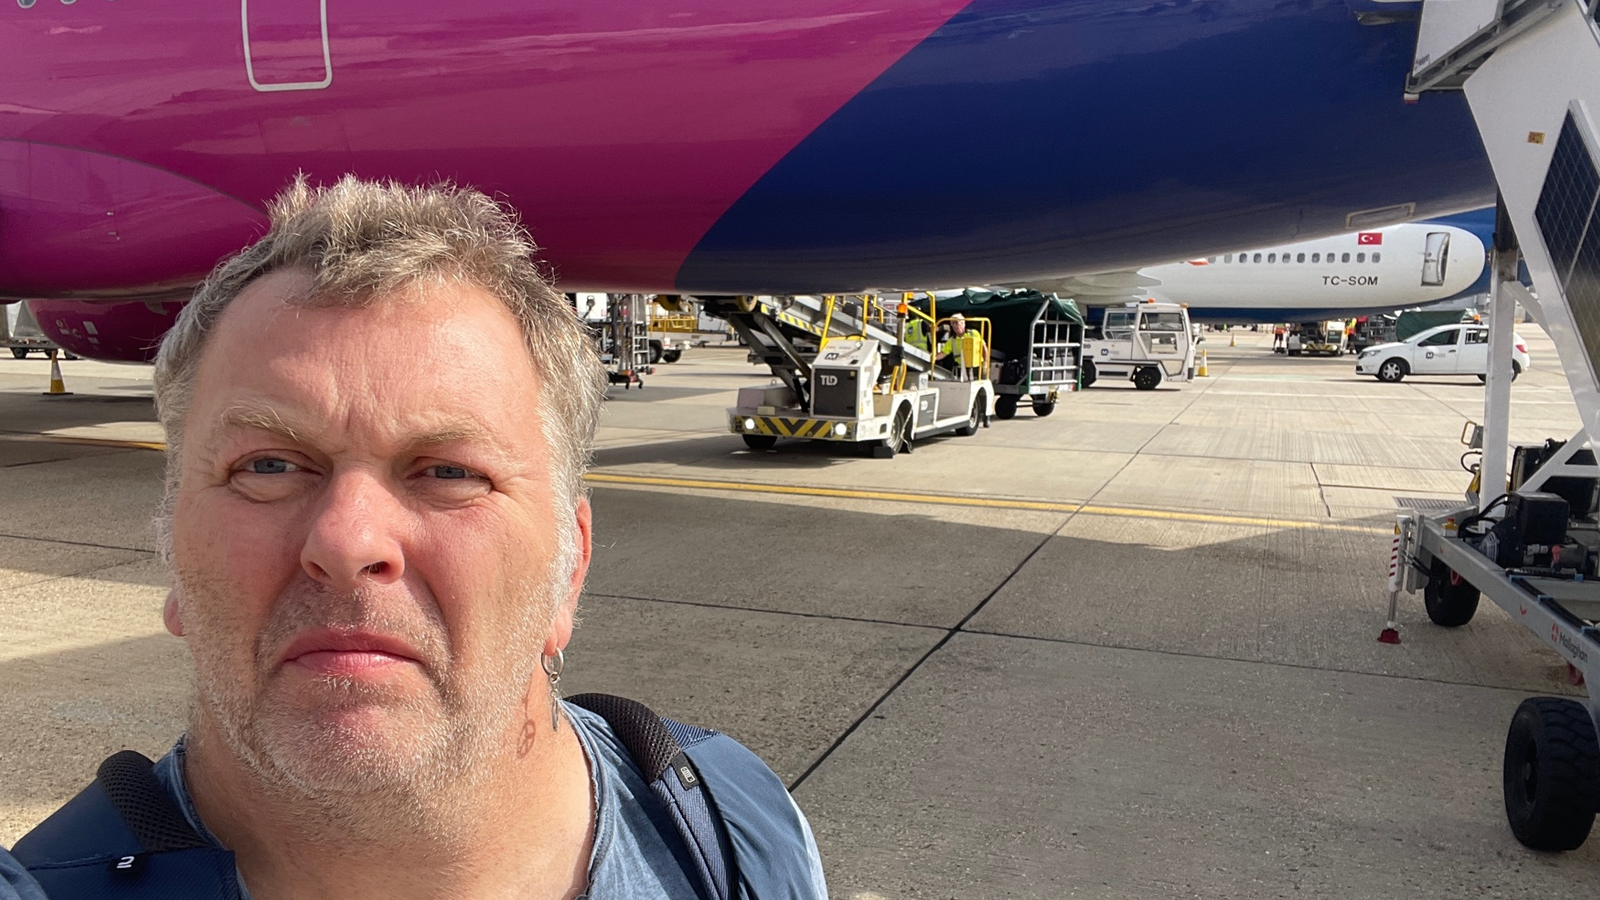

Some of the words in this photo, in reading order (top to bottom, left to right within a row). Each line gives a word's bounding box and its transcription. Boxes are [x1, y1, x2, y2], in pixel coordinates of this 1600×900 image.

[1322, 275, 1378, 286] TC-SOM
[820, 374, 838, 386] TLD
[1559, 631, 1588, 663] Mallaghan
